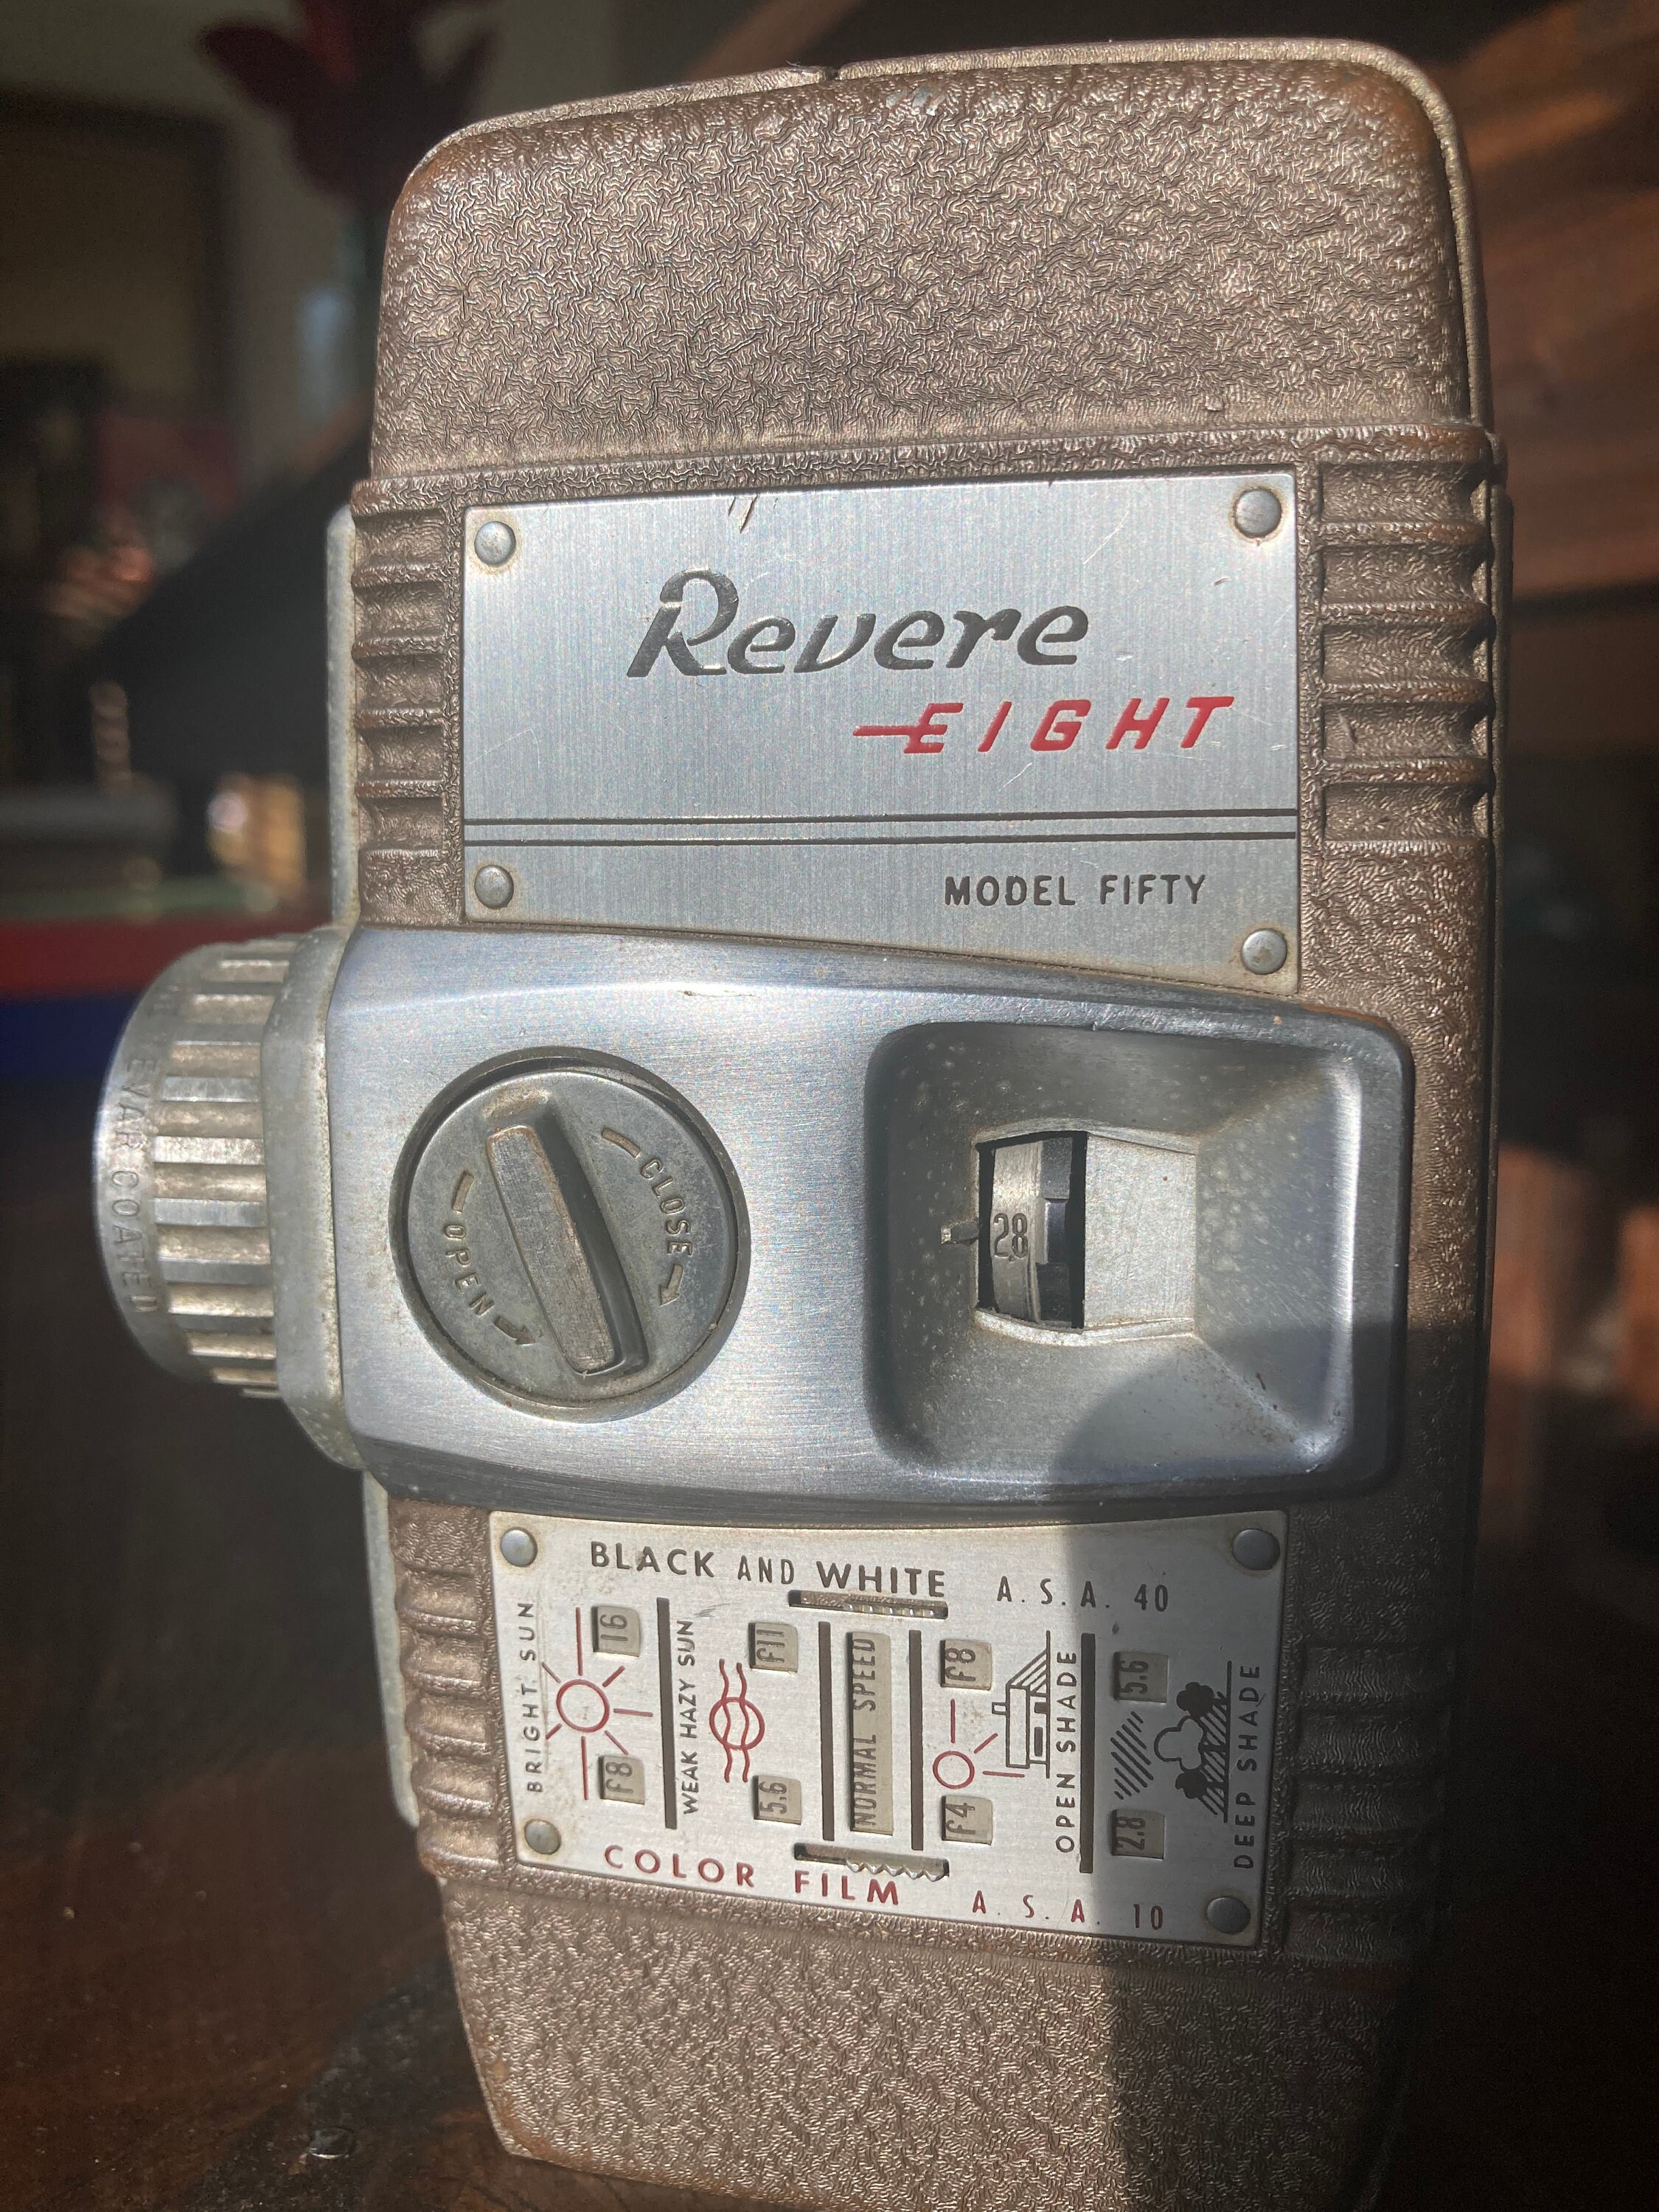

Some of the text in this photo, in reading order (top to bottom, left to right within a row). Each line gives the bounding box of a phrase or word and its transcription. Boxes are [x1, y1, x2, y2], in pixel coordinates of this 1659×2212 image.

[627, 567, 1088, 677] Revere
[852, 695, 1234, 754] EIGHT
[944, 873, 1206, 907] MODEL FIFTY
[639, 1157, 692, 1256] CLOSE
[444, 1224, 495, 1317] OPEN
[590, 1540, 714, 1579] BLACK
[737, 1555, 795, 1585] AND
[816, 1560, 945, 1598] WHITE
[1133, 1583, 1169, 1613] 40
[599, 1613, 629, 1642] 16
[517, 1603, 544, 1792] BRIGHT SUN
[673, 1621, 700, 1815] WEAK HAZY SUN
[1119, 1659, 1148, 1694] 5.6
[852, 1637, 877, 1826] NORMAL SPEED
[1056, 1652, 1077, 1853] OPEN SHADE
[1234, 1665, 1260, 1869] DEEP SHADE
[1114, 1817, 1147, 1848] 2.8
[604, 1844, 755, 1888] COLOR
[794, 1870, 900, 1905] FILM
[1133, 1903, 1164, 1930] 10
